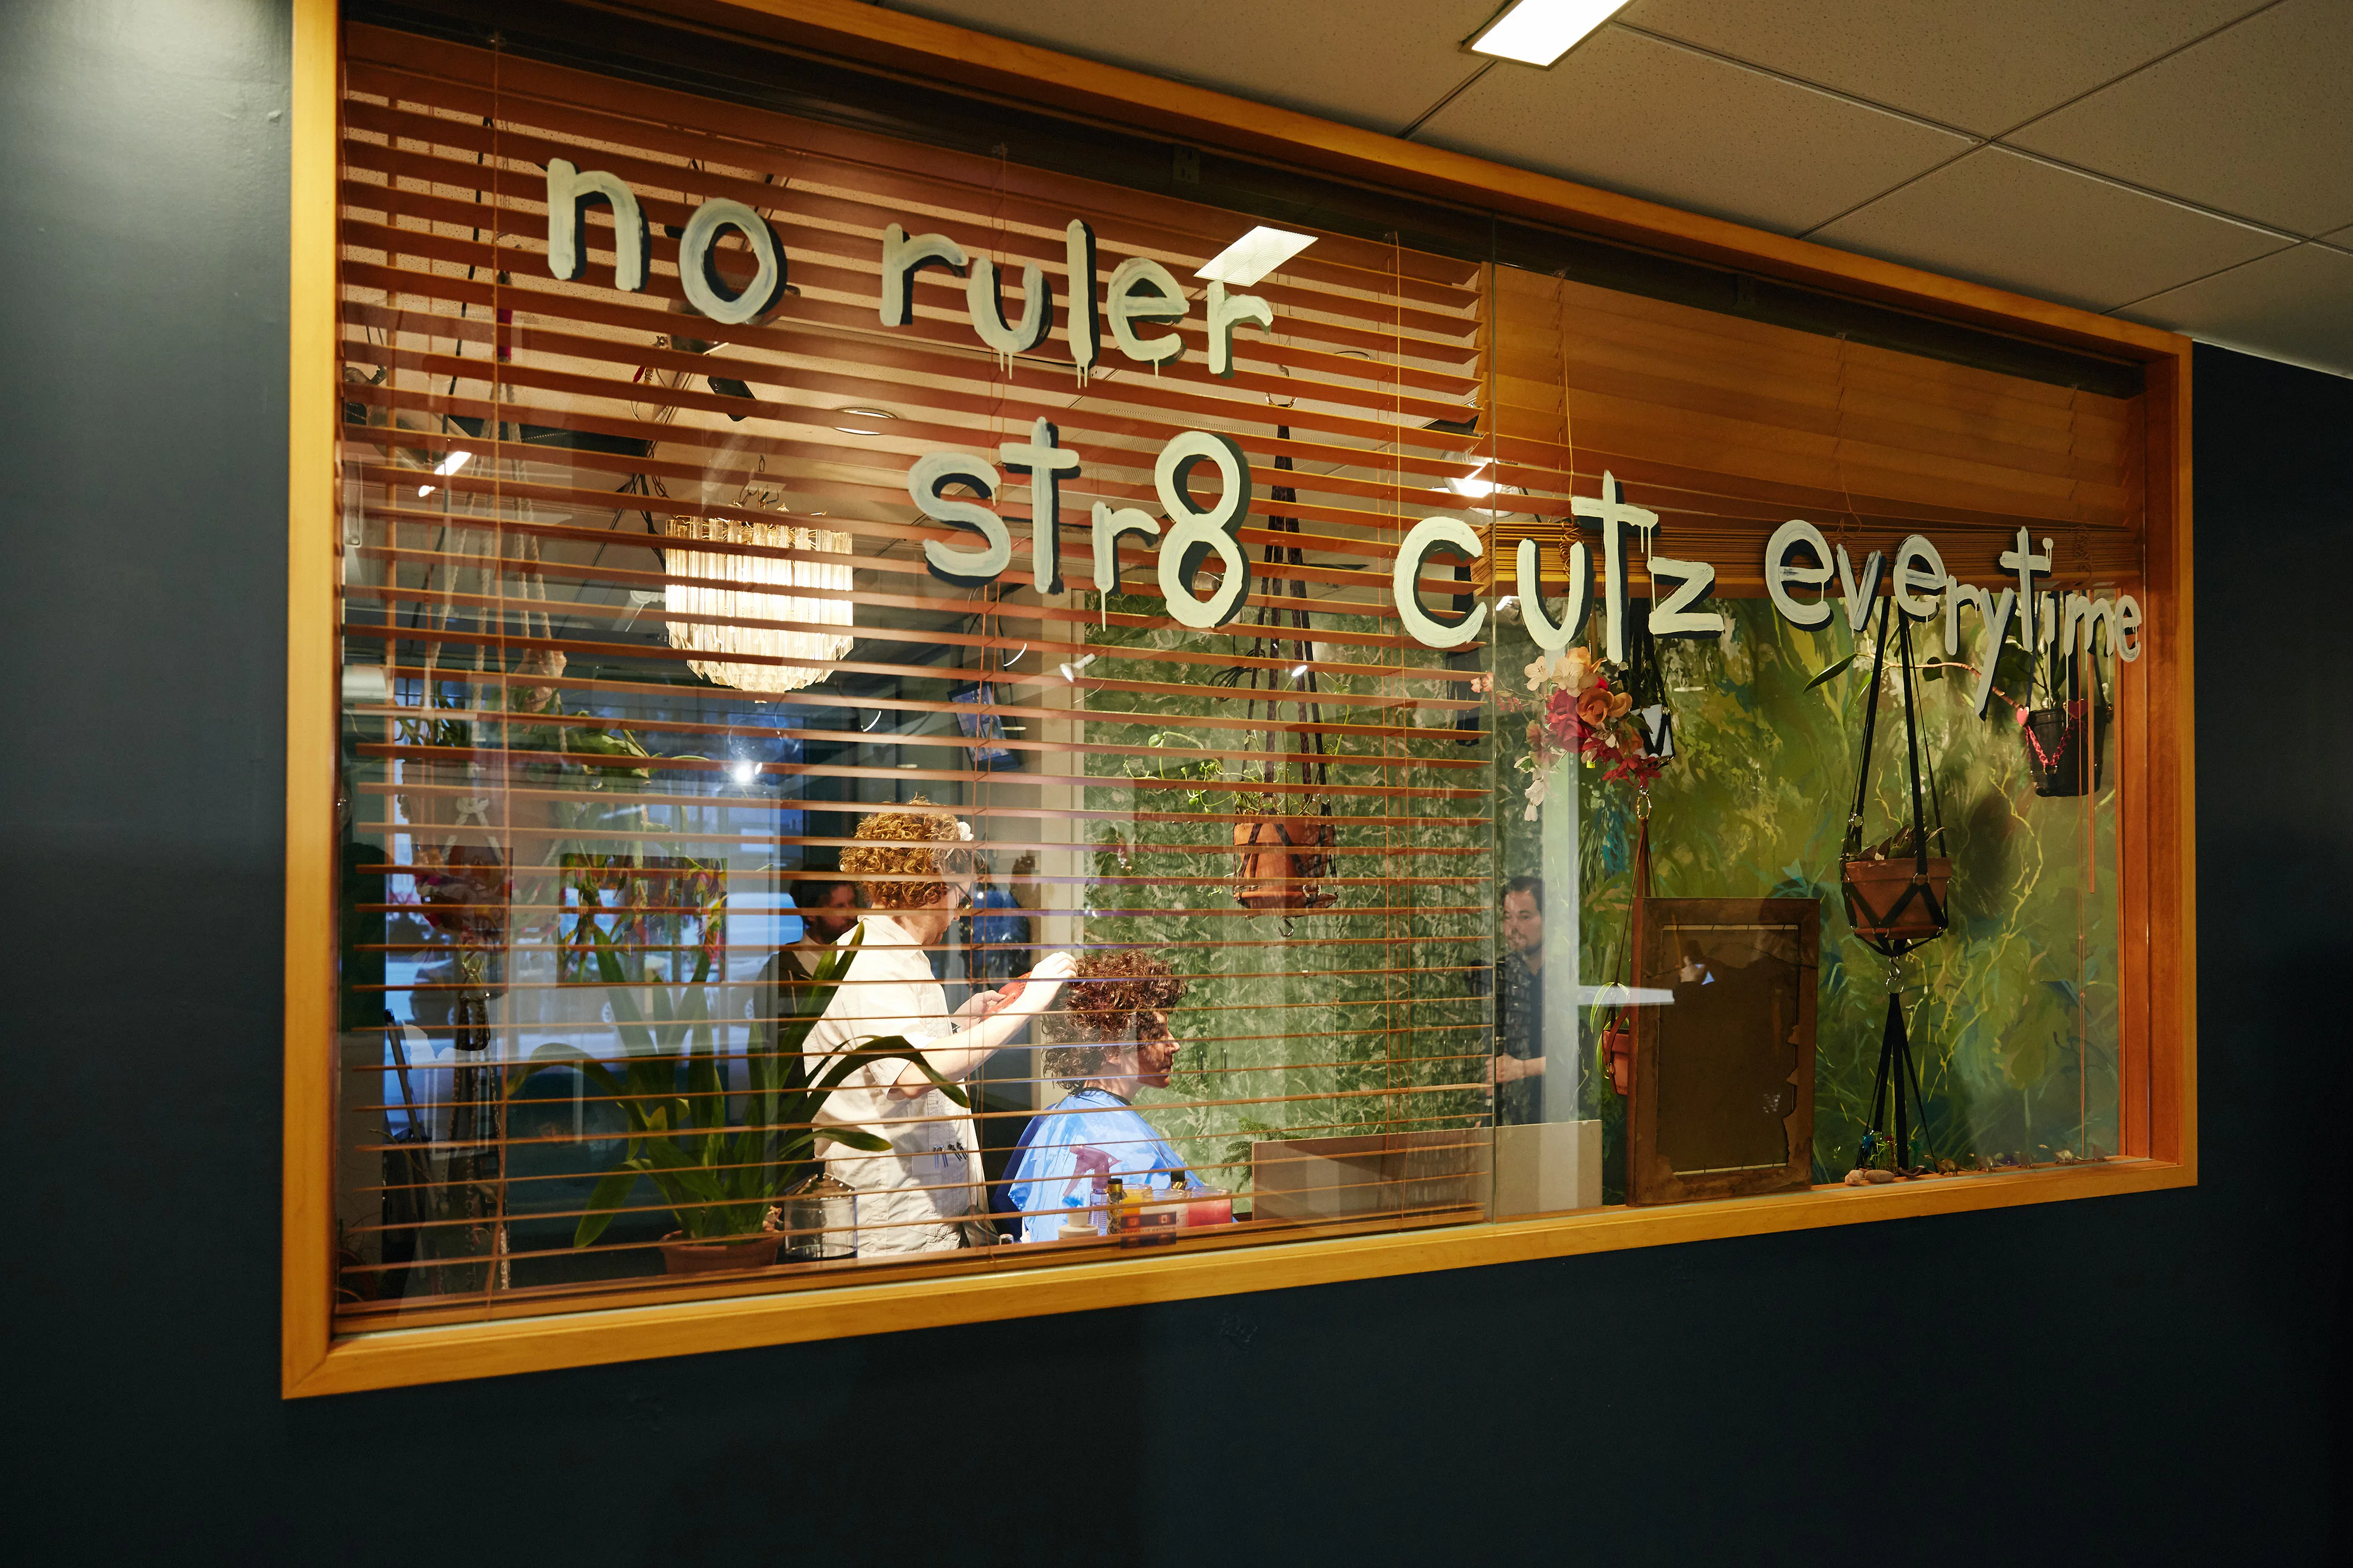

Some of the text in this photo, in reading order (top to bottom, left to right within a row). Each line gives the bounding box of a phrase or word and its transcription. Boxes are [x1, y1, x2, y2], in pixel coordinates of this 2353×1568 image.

[546, 157, 1274, 386] no ruler
[907, 416, 2142, 722] str8 cutz everytime
